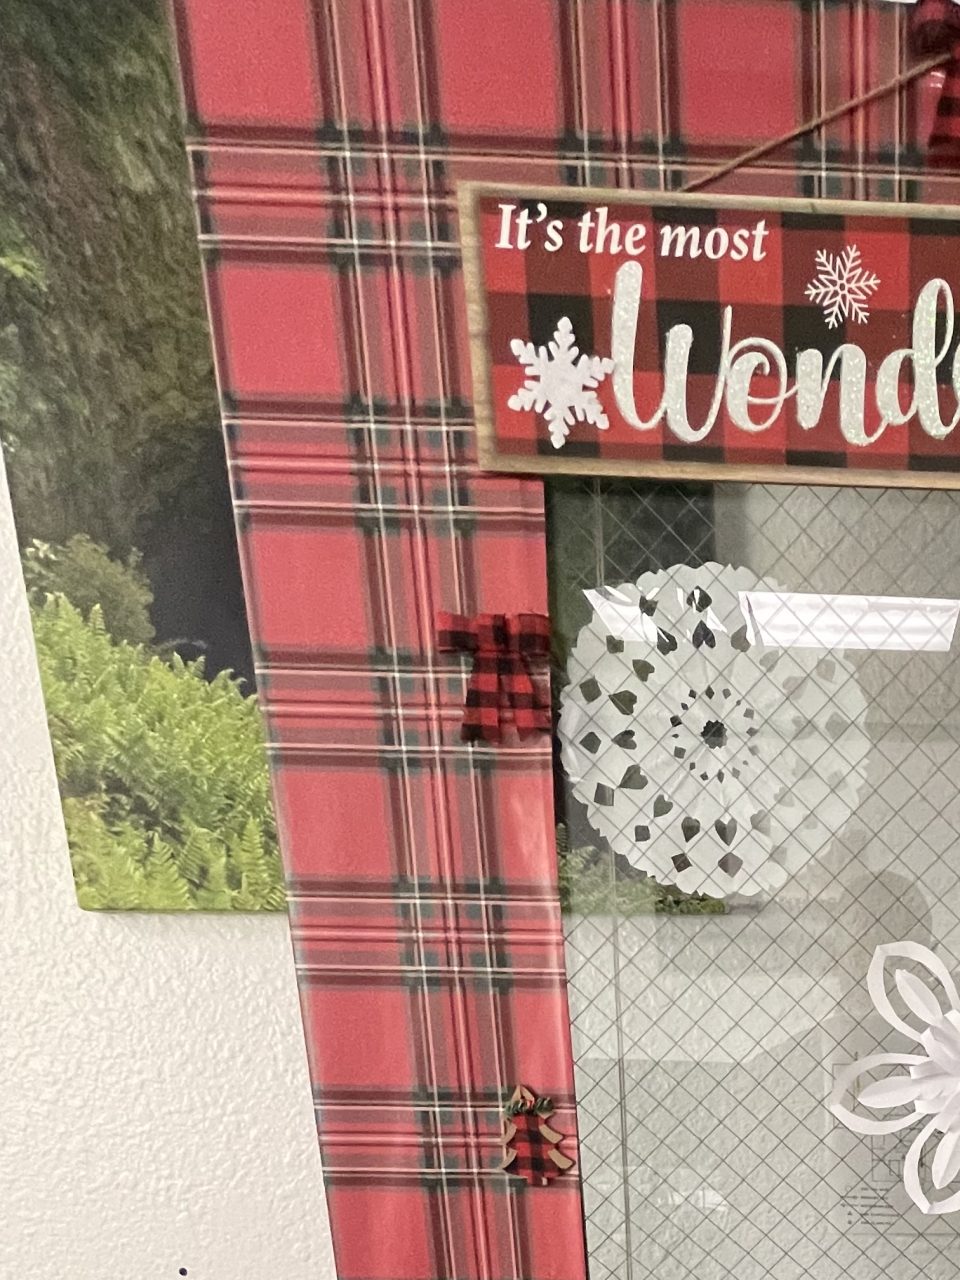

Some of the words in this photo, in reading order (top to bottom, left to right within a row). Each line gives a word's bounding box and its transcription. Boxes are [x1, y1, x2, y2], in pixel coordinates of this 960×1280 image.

[495, 203, 564, 252] It’s
[577, 206, 647, 256] the
[660, 219, 769, 262] most
